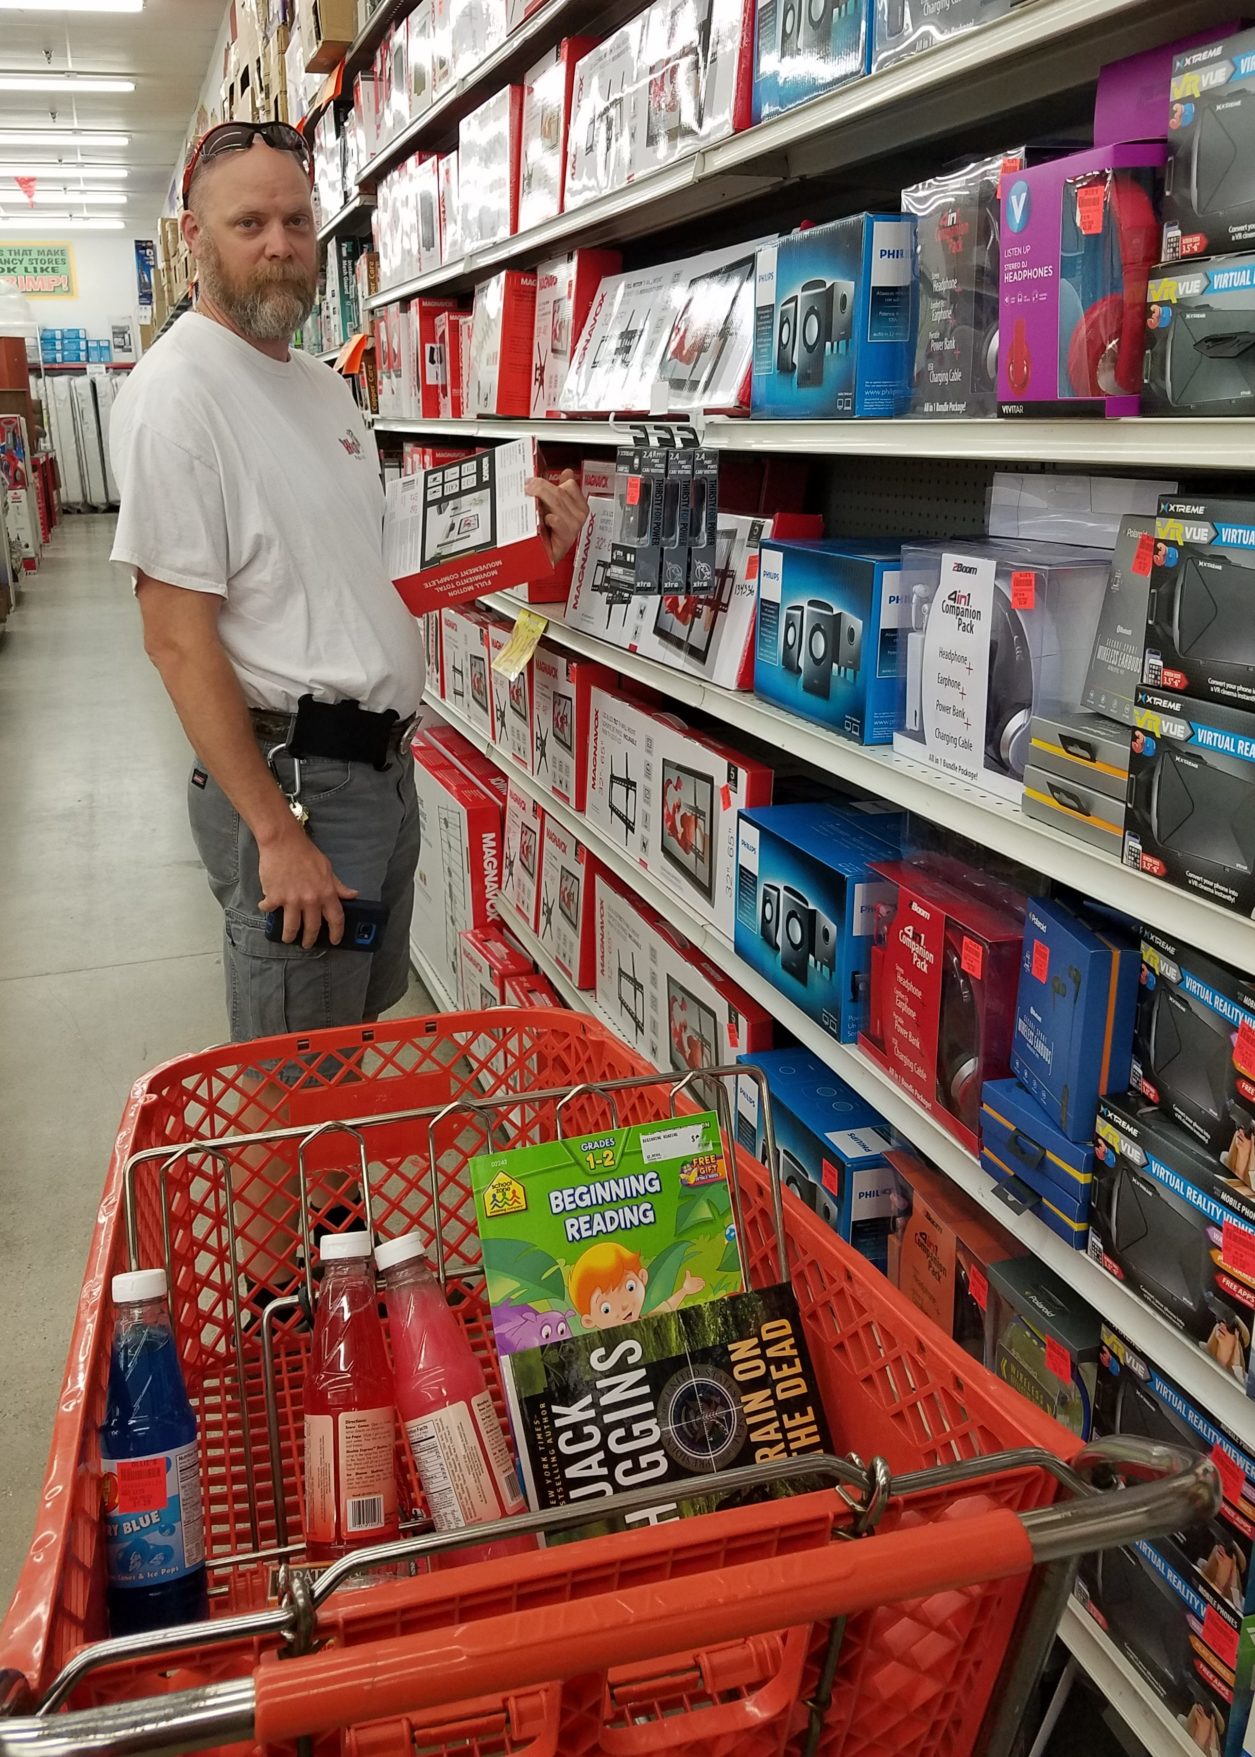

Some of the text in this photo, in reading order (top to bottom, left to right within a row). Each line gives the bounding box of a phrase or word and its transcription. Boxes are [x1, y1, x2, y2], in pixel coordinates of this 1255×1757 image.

[1184, 45, 1224, 67] XTREME
[1201, 67, 1226, 87] VUE
[9, 249, 67, 257] THAT MAKE
[28, 258, 67, 266] STORES
[1004, 245, 1031, 258] LISTEN UP
[25, 266, 60, 274] LIKE
[1004, 265, 1053, 284] HEADPHONES
[1178, 279, 1201, 295] VUE
[1213, 269, 1251, 290] VIRTUAL
[1002, 405, 1024, 414] VIVITAR
[651, 479, 665, 546] THIRSTY FOR POWER
[680, 480, 691, 547] THIRSTY FOR POWER
[706, 480, 717, 546] THIRSTY FOR POWER
[1168, 504, 1205, 515] XTREME
[1184, 526, 1209, 541] VUE
[572, 512, 596, 610] MAGNAVOX
[952, 562, 977, 575] 2Boom
[424, 559, 502, 589] MOUVEMENT COMPLETE
[435, 569, 498, 593] MOVIMIENTO TOTAL
[763, 570, 780, 582] PHILIPS
[448, 579, 492, 598] FULL MOTION
[941, 600, 982, 621] Companion
[957, 618, 974, 635] Pack
[938, 647, 968, 665] Headphone
[937, 672, 961, 690] Earphone
[935, 699, 965, 719] Power Bank
[1146, 695, 1181, 712] XTREME
[934, 727, 973, 752] Charging Cable
[1161, 719, 1185, 738] VUE
[1197, 727, 1235, 752] VIRTUAL
[591, 708, 600, 791] MAGNAVOX
[943, 759, 958, 773] Bundle
[958, 765, 978, 781] Package!
[741, 838, 757, 856] PHILIPS
[481, 832, 501, 923] MAGNAVOX
[1029, 912, 1047, 934] Polaroid
[899, 929, 934, 964] Companion
[1149, 932, 1176, 956] XTREME
[912, 952, 928, 974] Pack
[896, 971, 922, 1000] Headphone
[1160, 958, 1177, 980] VUE
[1185, 974, 1213, 1006] VIRTUAL
[1213, 994, 1243, 1025] REALITY
[894, 1020, 921, 1050] Power Bank
[894, 1046, 927, 1082] Charging Cable
[1106, 1110, 1139, 1138] XTREME
[581, 1137, 615, 1152] GRADES
[848, 1132, 873, 1153] PHILIPS
[586, 1149, 615, 1170] 1-2
[692, 1154, 717, 1167] FREE
[699, 1164, 718, 1175] GIFT
[491, 1180, 513, 1190] school
[495, 1186, 511, 1194] zone
[1120, 1141, 1142, 1166] VUE
[1151, 1159, 1185, 1196] VIRTUAL
[1186, 1187, 1222, 1220] REALITY
[549, 1170, 662, 1215] BEGINNING
[1220, 1191, 1241, 1212] MOBILE
[565, 1202, 656, 1242] READING
[1222, 1277, 1255, 1303] FREE APPS
[1029, 1294, 1056, 1318] Polaroid
[727, 1337, 767, 1382] ON
[760, 1318, 824, 1457] HE DEAD
[1124, 1352, 1146, 1378] VUE
[1154, 1378, 1187, 1417] VIRTUAL
[1187, 1409, 1222, 1448] REALITY
[539, 1402, 554, 1444] AUTHOR
[551, 1394, 614, 1500] JACK
[542, 1456, 551, 1483] YORK
[122, 1510, 160, 1535] BLUE
[147, 1566, 179, 1578] Ice Pops
[1166, 1568, 1200, 1611] REALITY
[1216, 1602, 1238, 1629] PHONES
